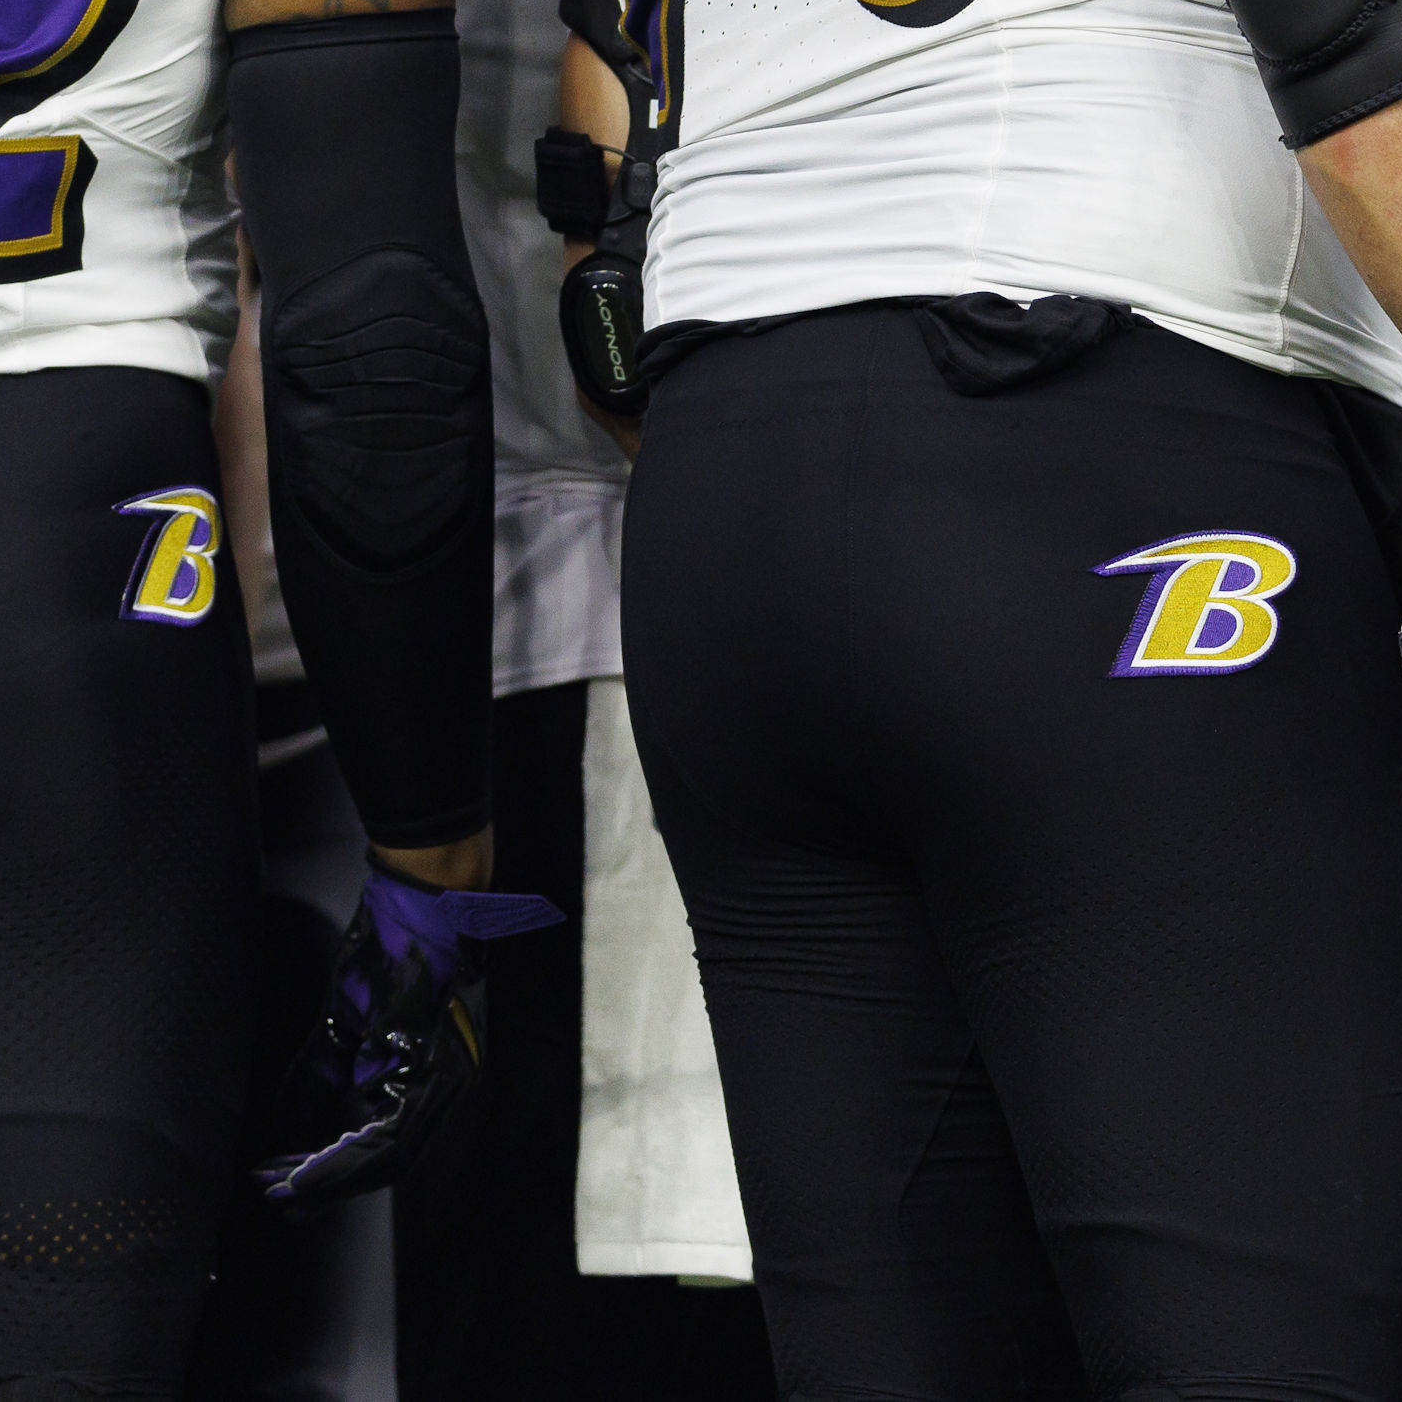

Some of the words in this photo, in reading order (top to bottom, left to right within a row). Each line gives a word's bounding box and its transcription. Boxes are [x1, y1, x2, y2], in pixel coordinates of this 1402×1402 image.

[596, 293, 627, 382] DONJOY
[101, 484, 223, 628] B
[1086, 529, 1299, 679] B
